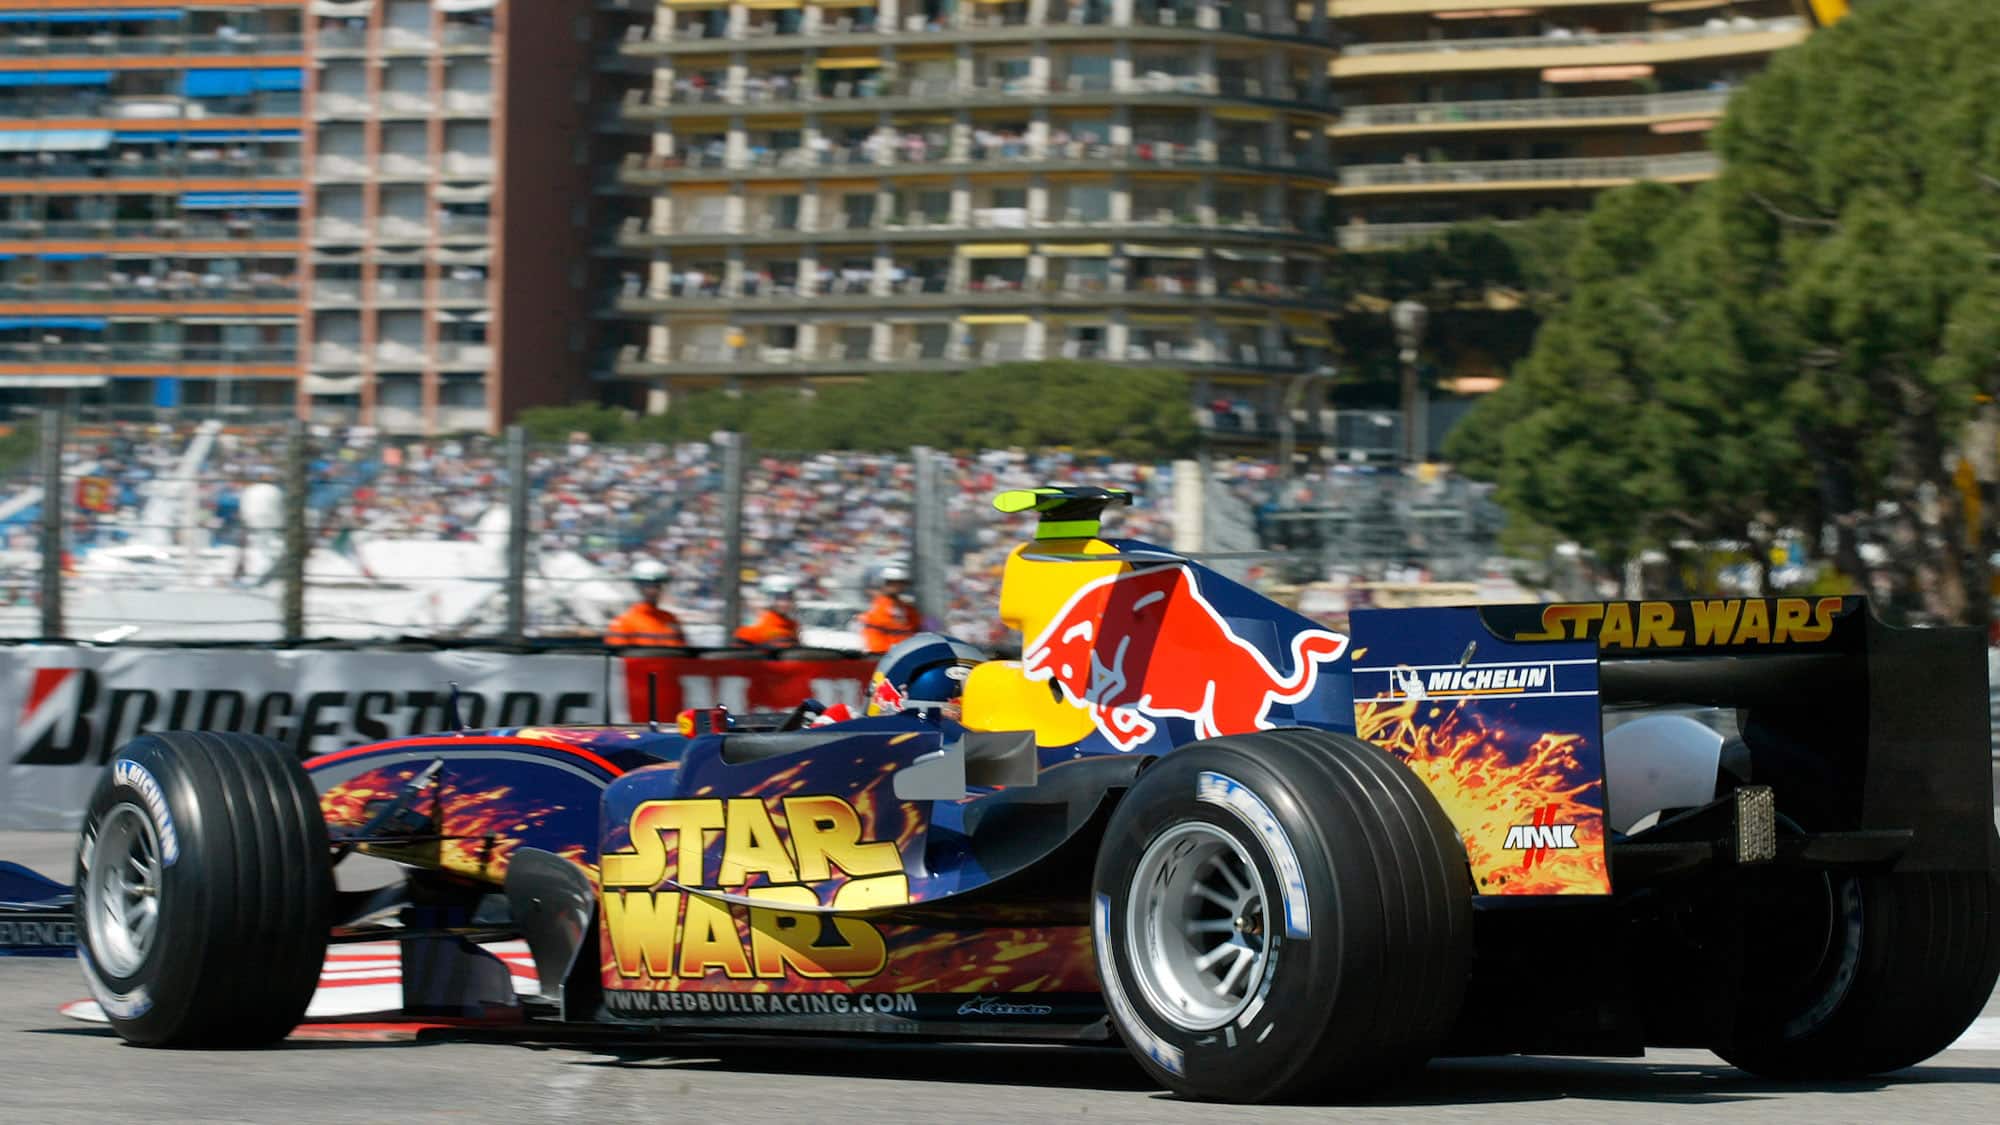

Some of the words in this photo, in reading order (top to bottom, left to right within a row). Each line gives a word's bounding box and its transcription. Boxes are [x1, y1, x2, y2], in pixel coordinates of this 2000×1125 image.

[1515, 602, 1685, 648] STAR
[1691, 597, 1842, 645] WARS
[1428, 668, 1547, 690] MICHELIN
[602, 795, 904, 888] STAR
[602, 873, 911, 979] WARS
[604, 990, 917, 1013] WWW.REDBULLRACING.COM
